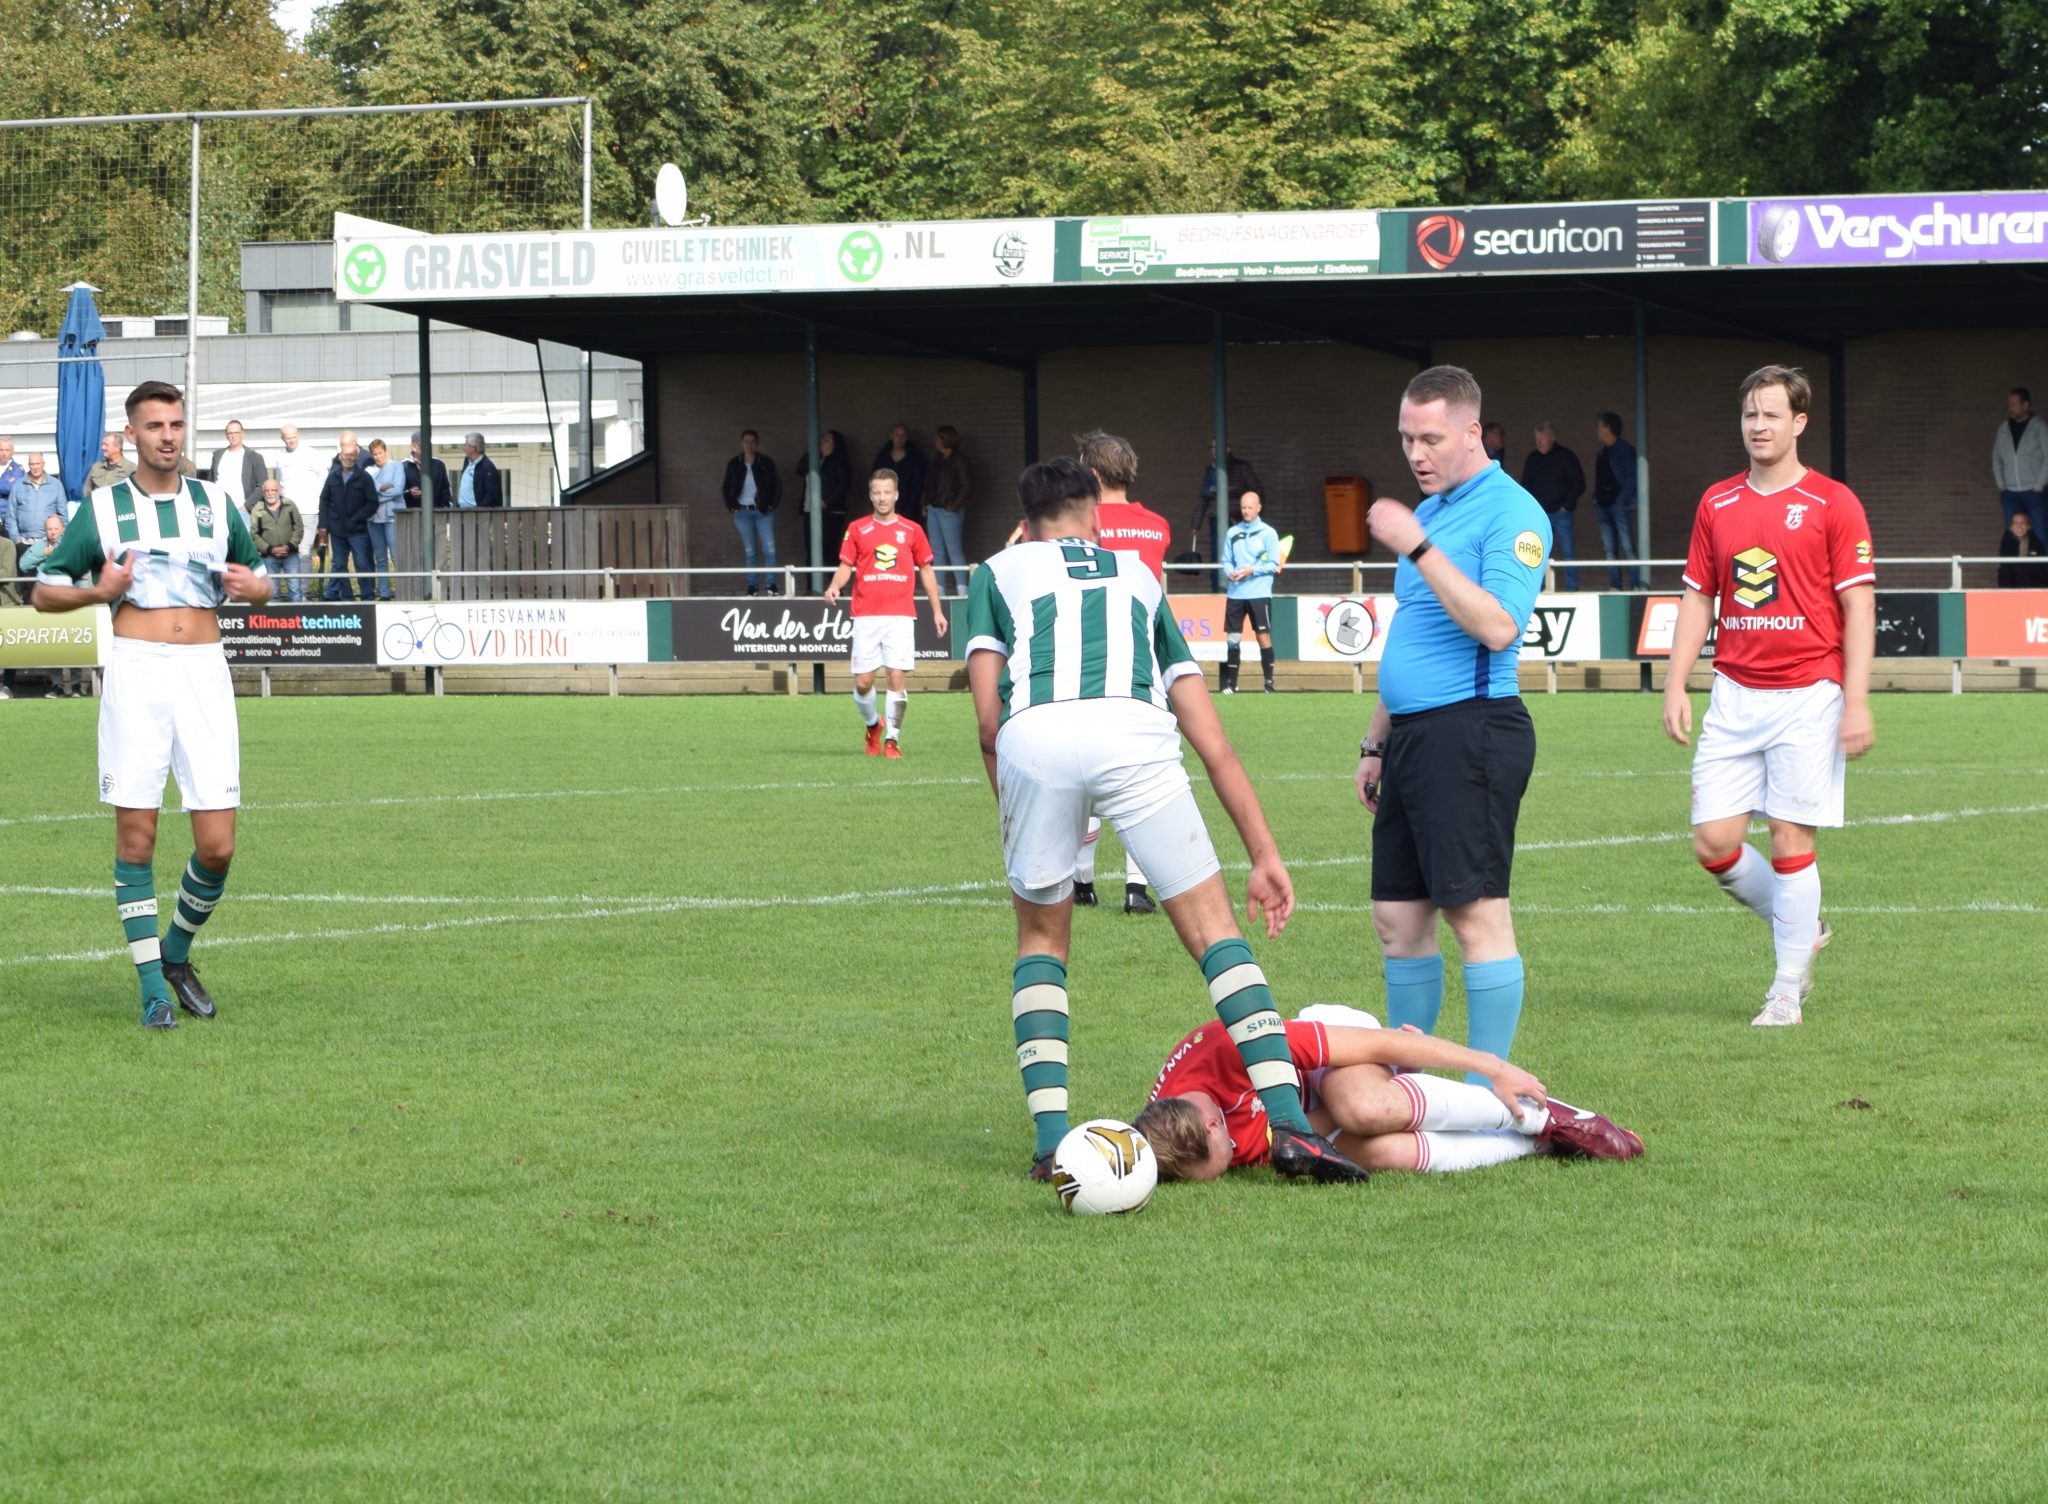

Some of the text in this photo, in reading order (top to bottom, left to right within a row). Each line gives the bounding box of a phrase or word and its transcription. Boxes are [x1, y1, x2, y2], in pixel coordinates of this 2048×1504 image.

[1473, 219, 1623, 256] securicon
[622, 236, 793, 264] CIVIELE TECHNIEK
[1099, 251, 1129, 260] SERVICE
[404, 241, 596, 291] GRASVELD
[117, 512, 136, 522] JAKO
[1100, 528, 1162, 541] AN STIPHOUT
[1518, 541, 1542, 557] ARAG
[216, 614, 362, 629] kers Klimaattechniek
[467, 608, 567, 623] FIETSVAKMAN
[720, 607, 769, 641] Van
[773, 609, 810, 641] der
[1180, 618, 1212, 638] RS
[1523, 611, 1571, 652] ey
[6, 627, 70, 645] SPARTA
[291, 635, 362, 646] luchtbehandeling
[468, 629, 567, 657] V/D BERG
[224, 648, 321, 658] age service onderhoud
[734, 644, 788, 652] INTERIEUR
[799, 644, 848, 652] MONTAGE
